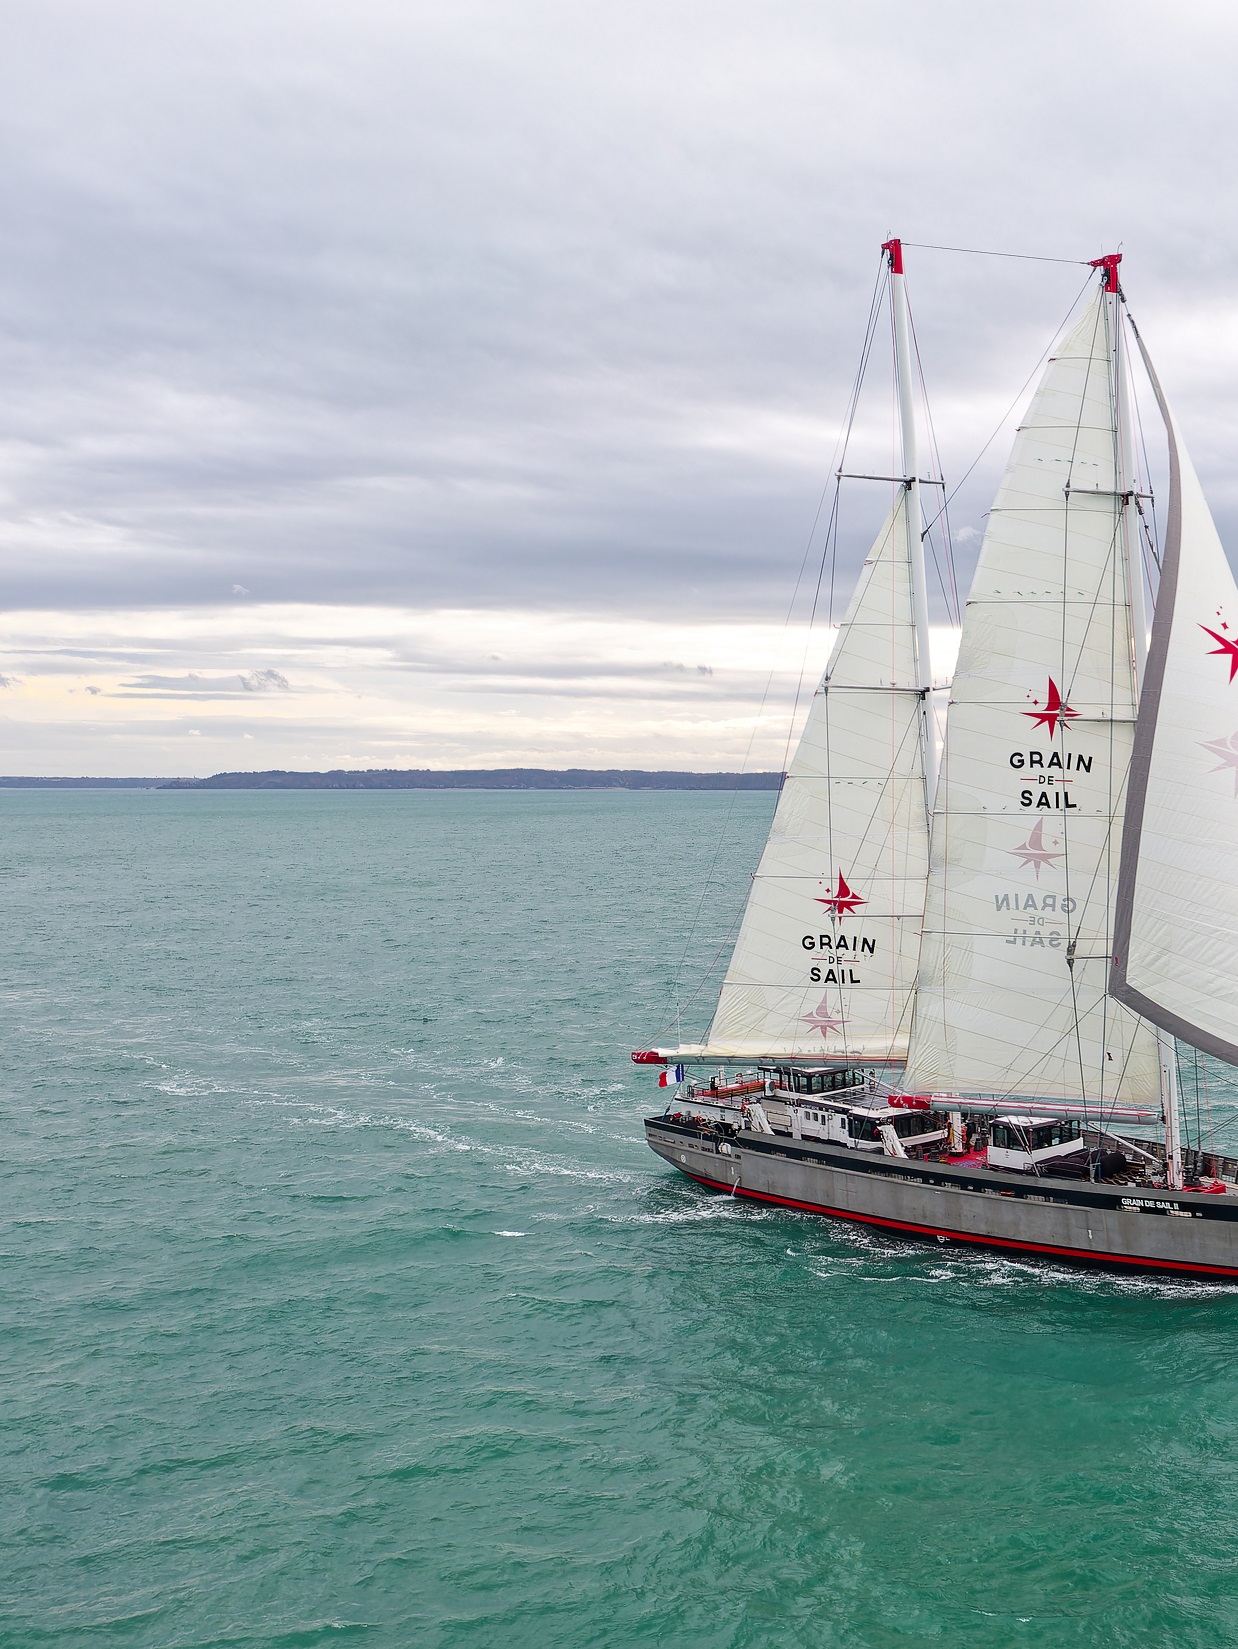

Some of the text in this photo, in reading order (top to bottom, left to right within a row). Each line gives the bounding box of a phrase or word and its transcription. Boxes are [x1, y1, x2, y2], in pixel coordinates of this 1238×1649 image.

[1009, 751, 1093, 773] GRAIN
[1038, 775, 1054, 785] DE
[1020, 789, 1077, 809] SAIL
[802, 934, 876, 954] GRAIN
[828, 955, 843, 965] DE
[809, 967, 861, 984] SAIL
[1121, 1198, 1180, 1210] GRAIN DE SAIL II
